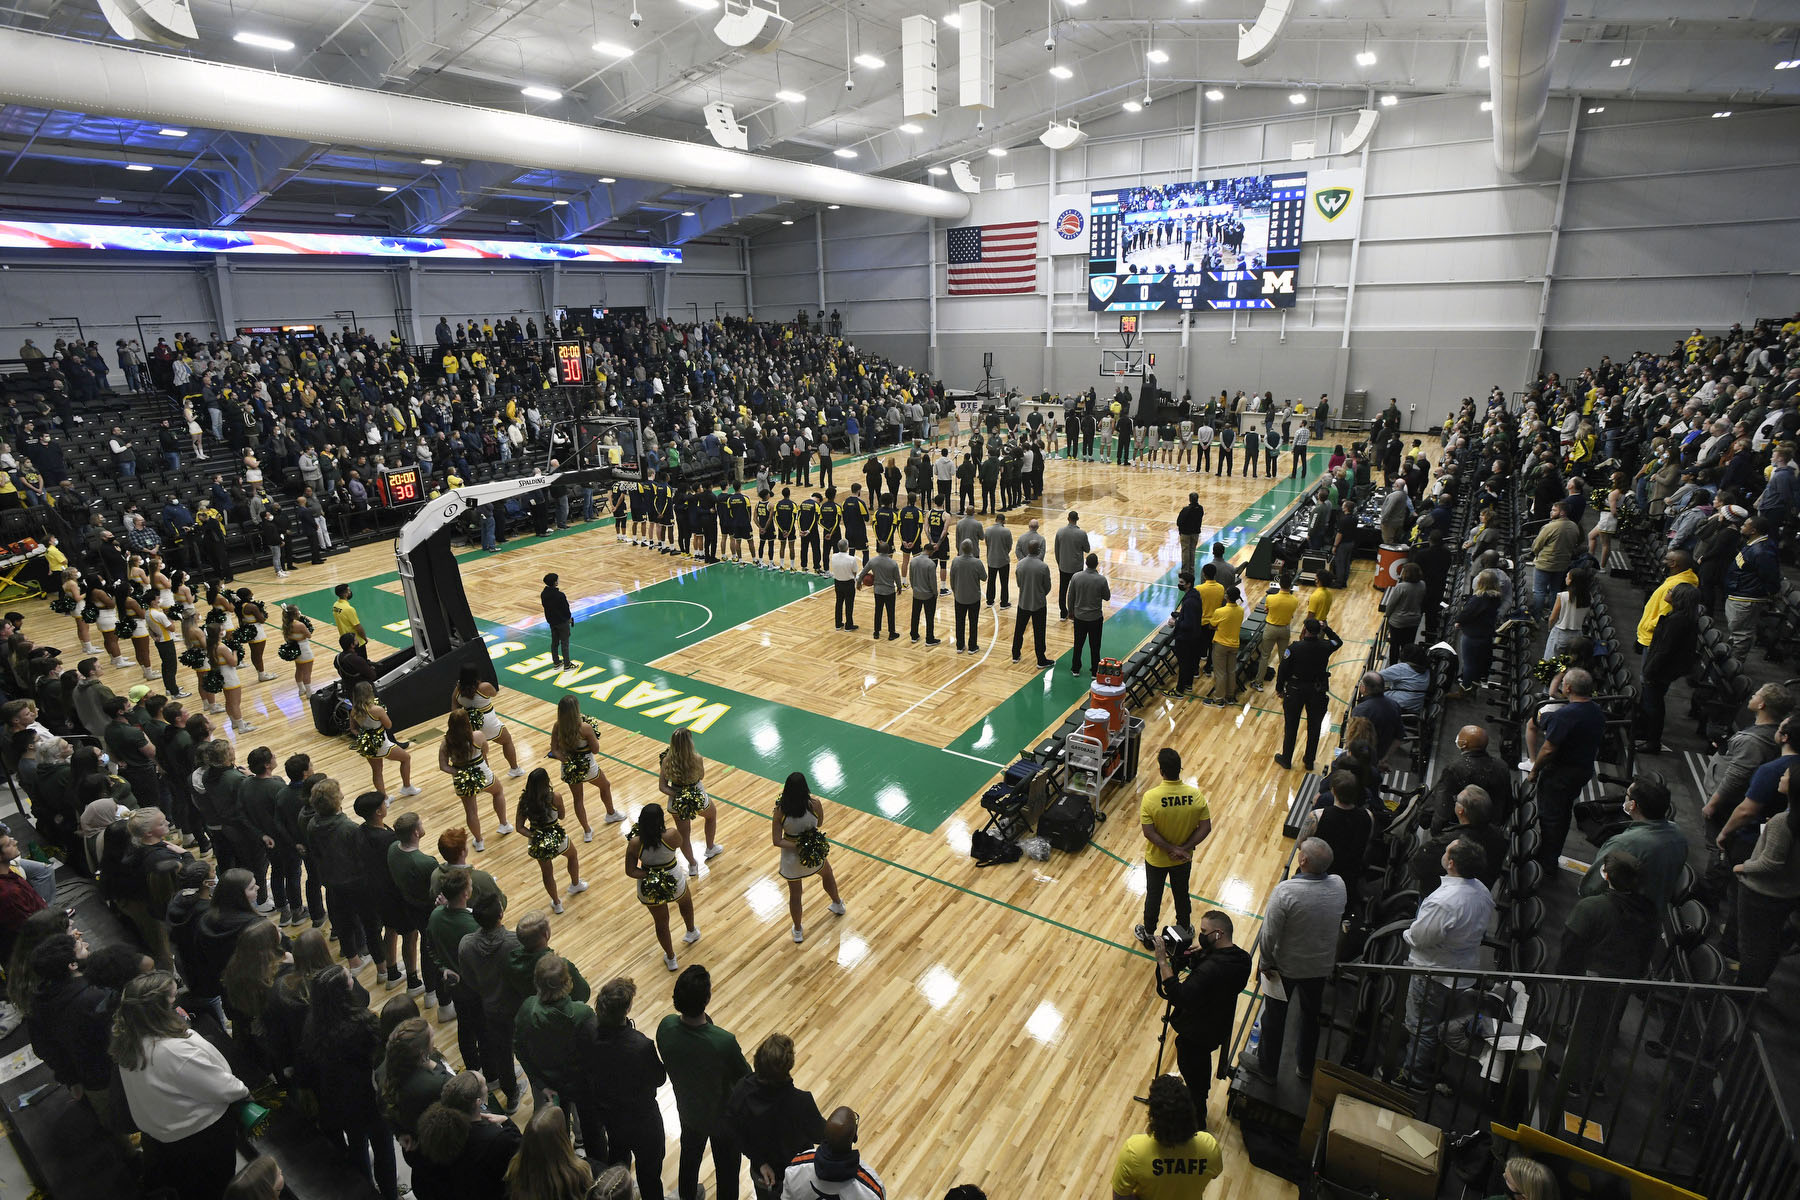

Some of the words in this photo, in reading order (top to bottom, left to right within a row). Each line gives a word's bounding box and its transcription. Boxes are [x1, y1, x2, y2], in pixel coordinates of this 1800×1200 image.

[1318, 193, 1347, 212] W
[1173, 273, 1201, 287] 20:00
[1262, 270, 1294, 294] M
[1140, 285, 1149, 300] 0
[1228, 282, 1237, 298] 0
[559, 346, 580, 358] 20:00
[562, 360, 580, 380] 30
[388, 472, 416, 486] 20:00
[519, 477, 546, 487] SPALDING
[396, 484, 414, 500] 30
[758, 508, 766, 516] 55
[931, 517, 940, 526] 23
[505, 651, 732, 734] WAYNE
[1071, 745, 1096, 754] GATORADE
[1161, 796, 1193, 807] STAFF
[1152, 1158, 1208, 1176] STAFF
